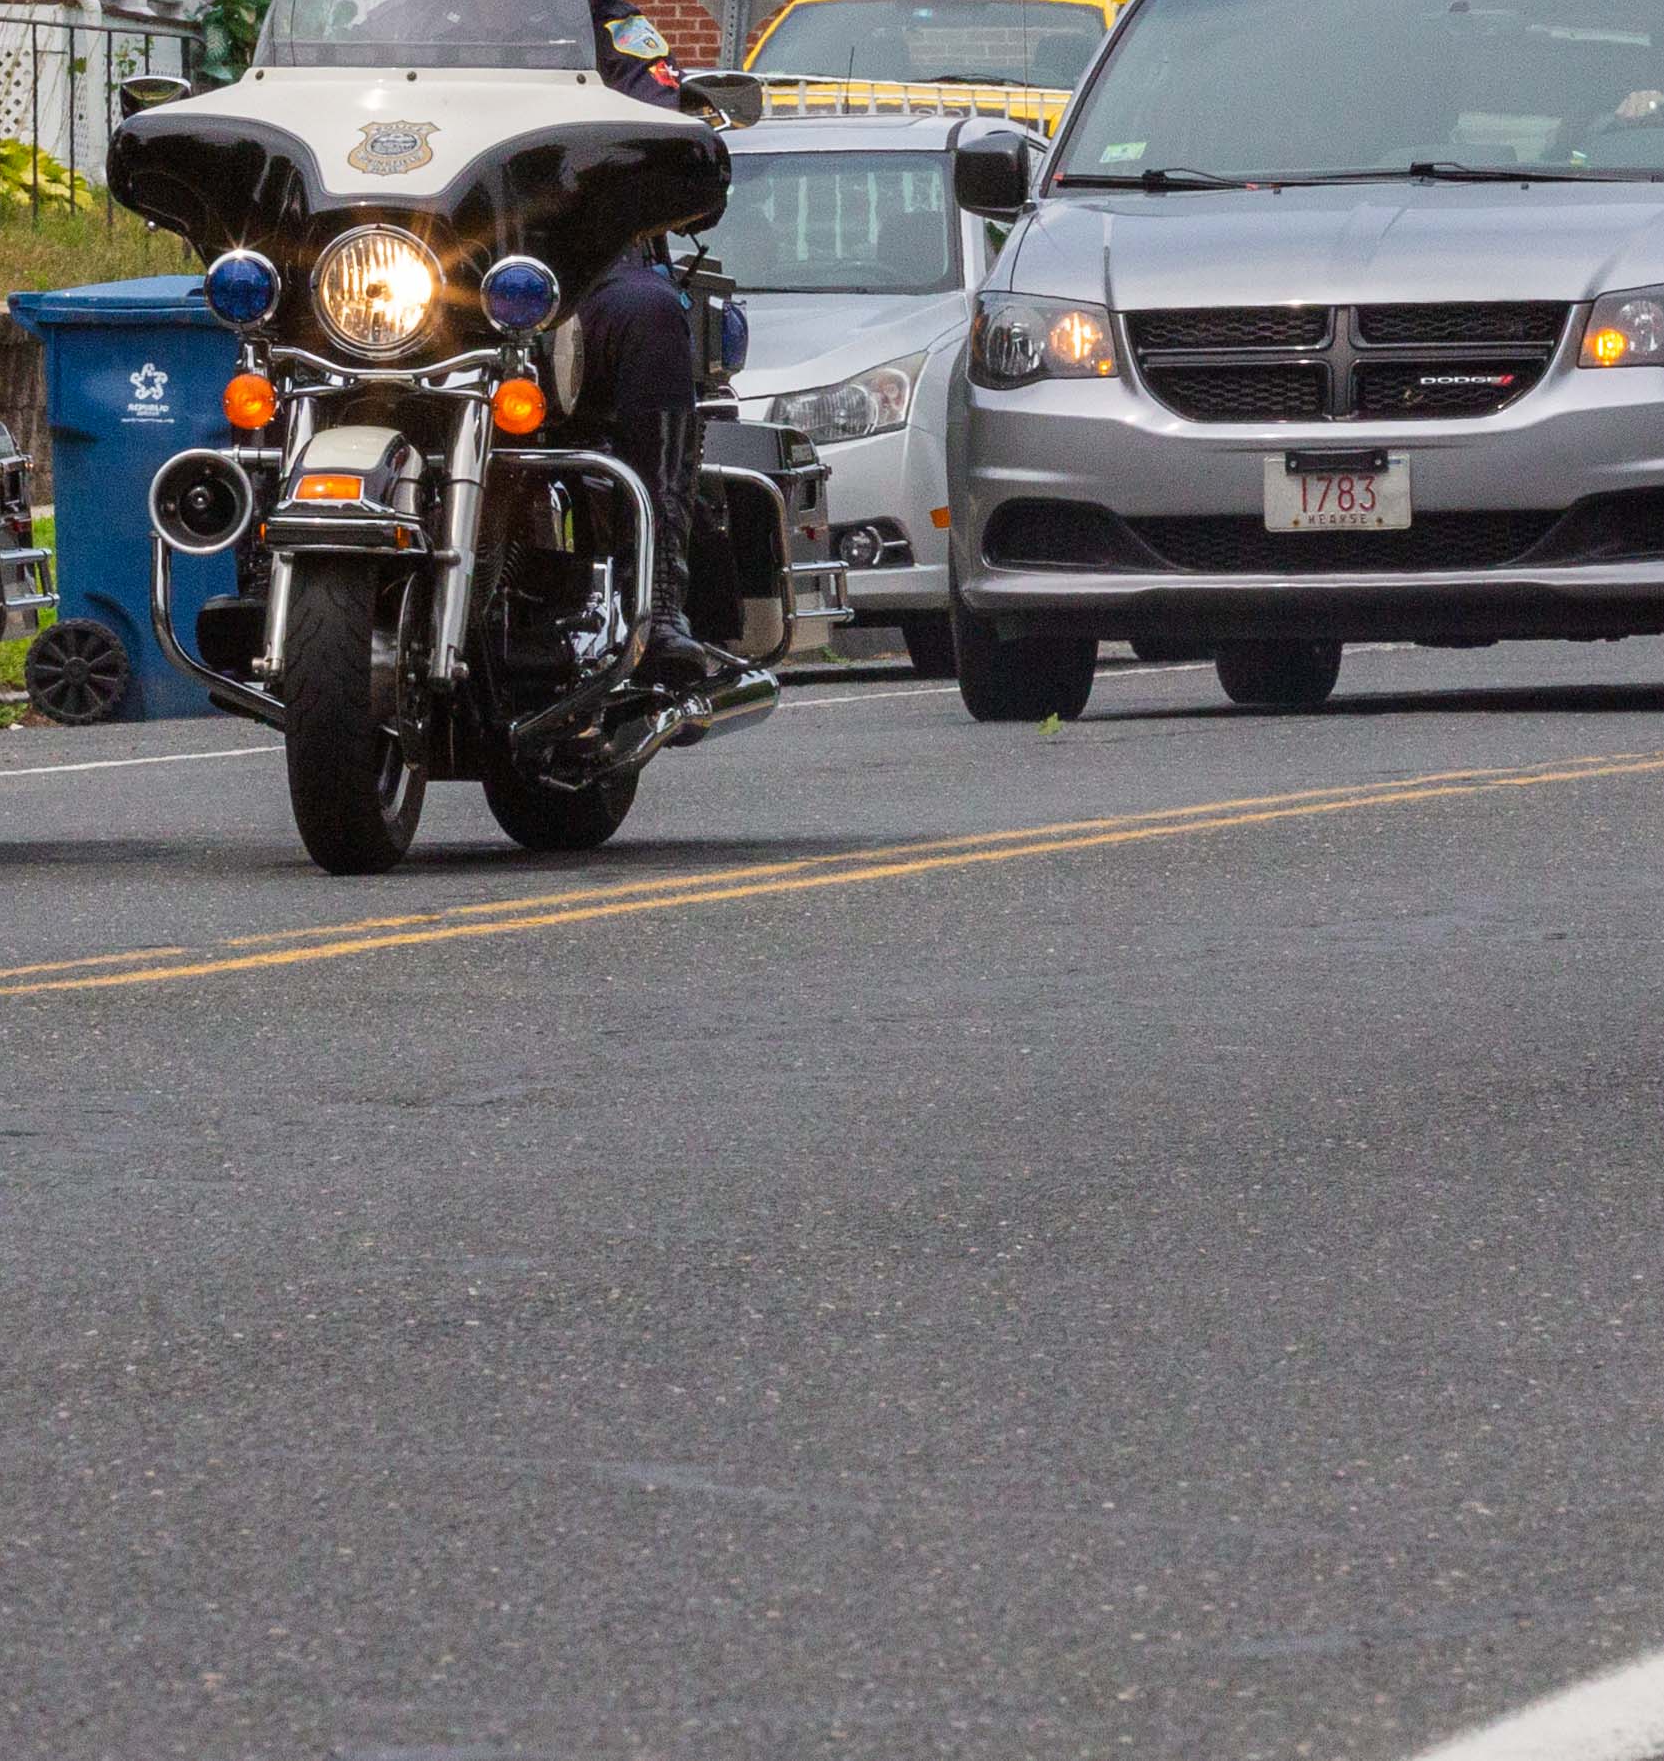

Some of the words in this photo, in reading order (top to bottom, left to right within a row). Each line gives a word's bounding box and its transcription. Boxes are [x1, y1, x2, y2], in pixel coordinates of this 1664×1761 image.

[1419, 376, 1501, 385] DODGE
[1299, 475, 1377, 513] 1783
[1307, 513, 1369, 526] HEARSE
